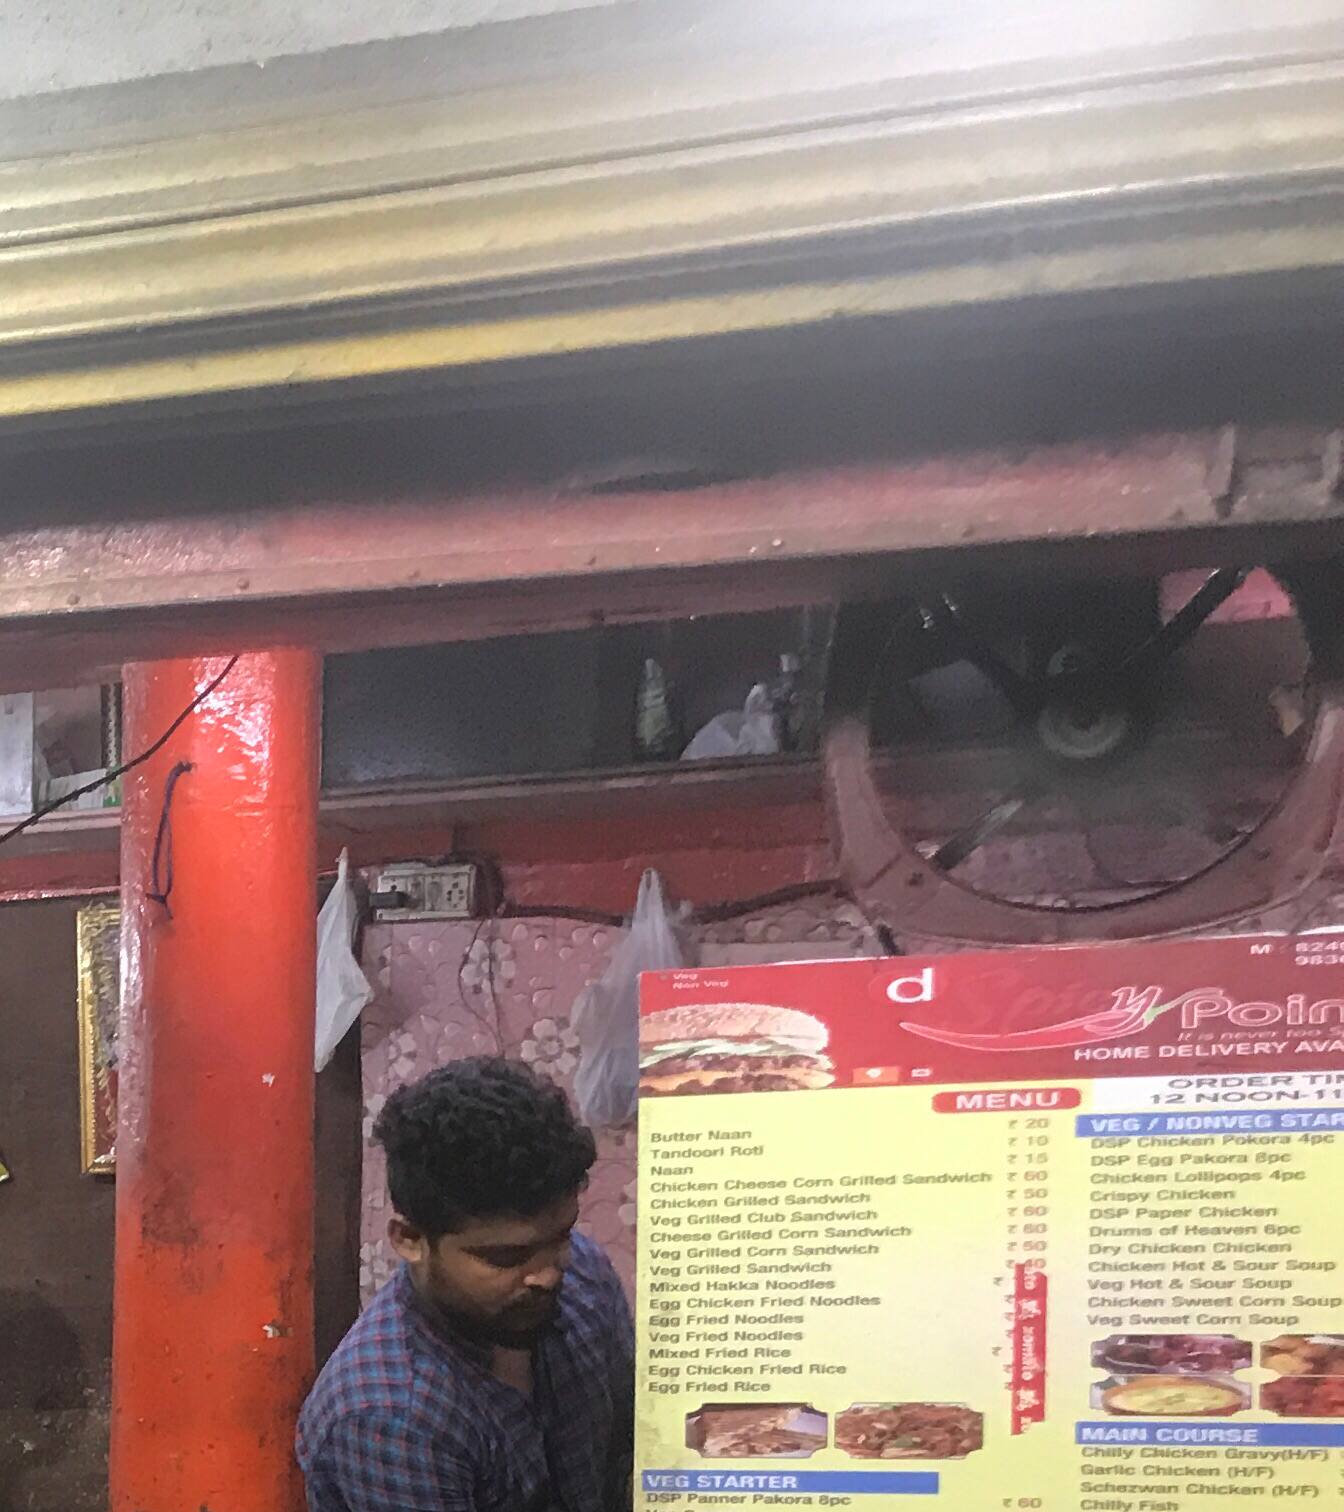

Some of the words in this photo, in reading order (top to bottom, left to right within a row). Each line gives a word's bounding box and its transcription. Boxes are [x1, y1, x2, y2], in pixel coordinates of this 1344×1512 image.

[886, 968, 933, 1003] d
[1074, 1046, 1150, 1061] HOME
[1158, 1041, 1289, 1058] DELIVERY
[1168, 1076, 1292, 1089] ORDER
[955, 1092, 1060, 1110] MENU
[1090, 1117, 1141, 1132] VEG
[1166, 1115, 1272, 1131] NONVEG
[651, 1131, 702, 1143] Butter
[708, 1129, 752, 1141] Naan
[651, 1148, 725, 1160] Tandoori
[731, 1145, 764, 1157] Roti
[651, 1165, 694, 1176] Naan
[1090, 1173, 1167, 1184] Chicken
[1175, 1171, 1261, 1183] Lollipops
[1269, 1170, 1306, 1181] 4pc
[651, 1181, 718, 1194] Chicken
[725, 1179, 787, 1191] Cheese
[793, 1176, 833, 1189] Corn
[839, 1174, 897, 1187] Grilled
[903, 1171, 992, 1185] Sandwich
[1090, 1190, 1149, 1203] Crispy
[1156, 1189, 1235, 1200] Chicken
[650, 1214, 681, 1227] Veg
[687, 1212, 742, 1225] Grilled
[748, 1211, 786, 1224] Club
[790, 1208, 878, 1221] Sandwich
[649, 1281, 700, 1293] Mixed
[706, 1279, 760, 1291] Hakka
[766, 1278, 836, 1290] Noodles
[649, 1364, 680, 1377] Egg
[686, 1363, 754, 1375] Chicken
[759, 1362, 804, 1374] Fried
[809, 1362, 847, 1374] Rice
[1081, 1427, 1147, 1441] MAIN
[1155, 1428, 1259, 1443] COURSE
[1080, 1465, 1136, 1476] Garlic
[1143, 1465, 1220, 1478] Chicken
[646, 1475, 689, 1488] VEG
[696, 1476, 797, 1490] STARTER
[1080, 1500, 1132, 1512] Chilly
[1139, 1501, 1179, 1512] Fish
